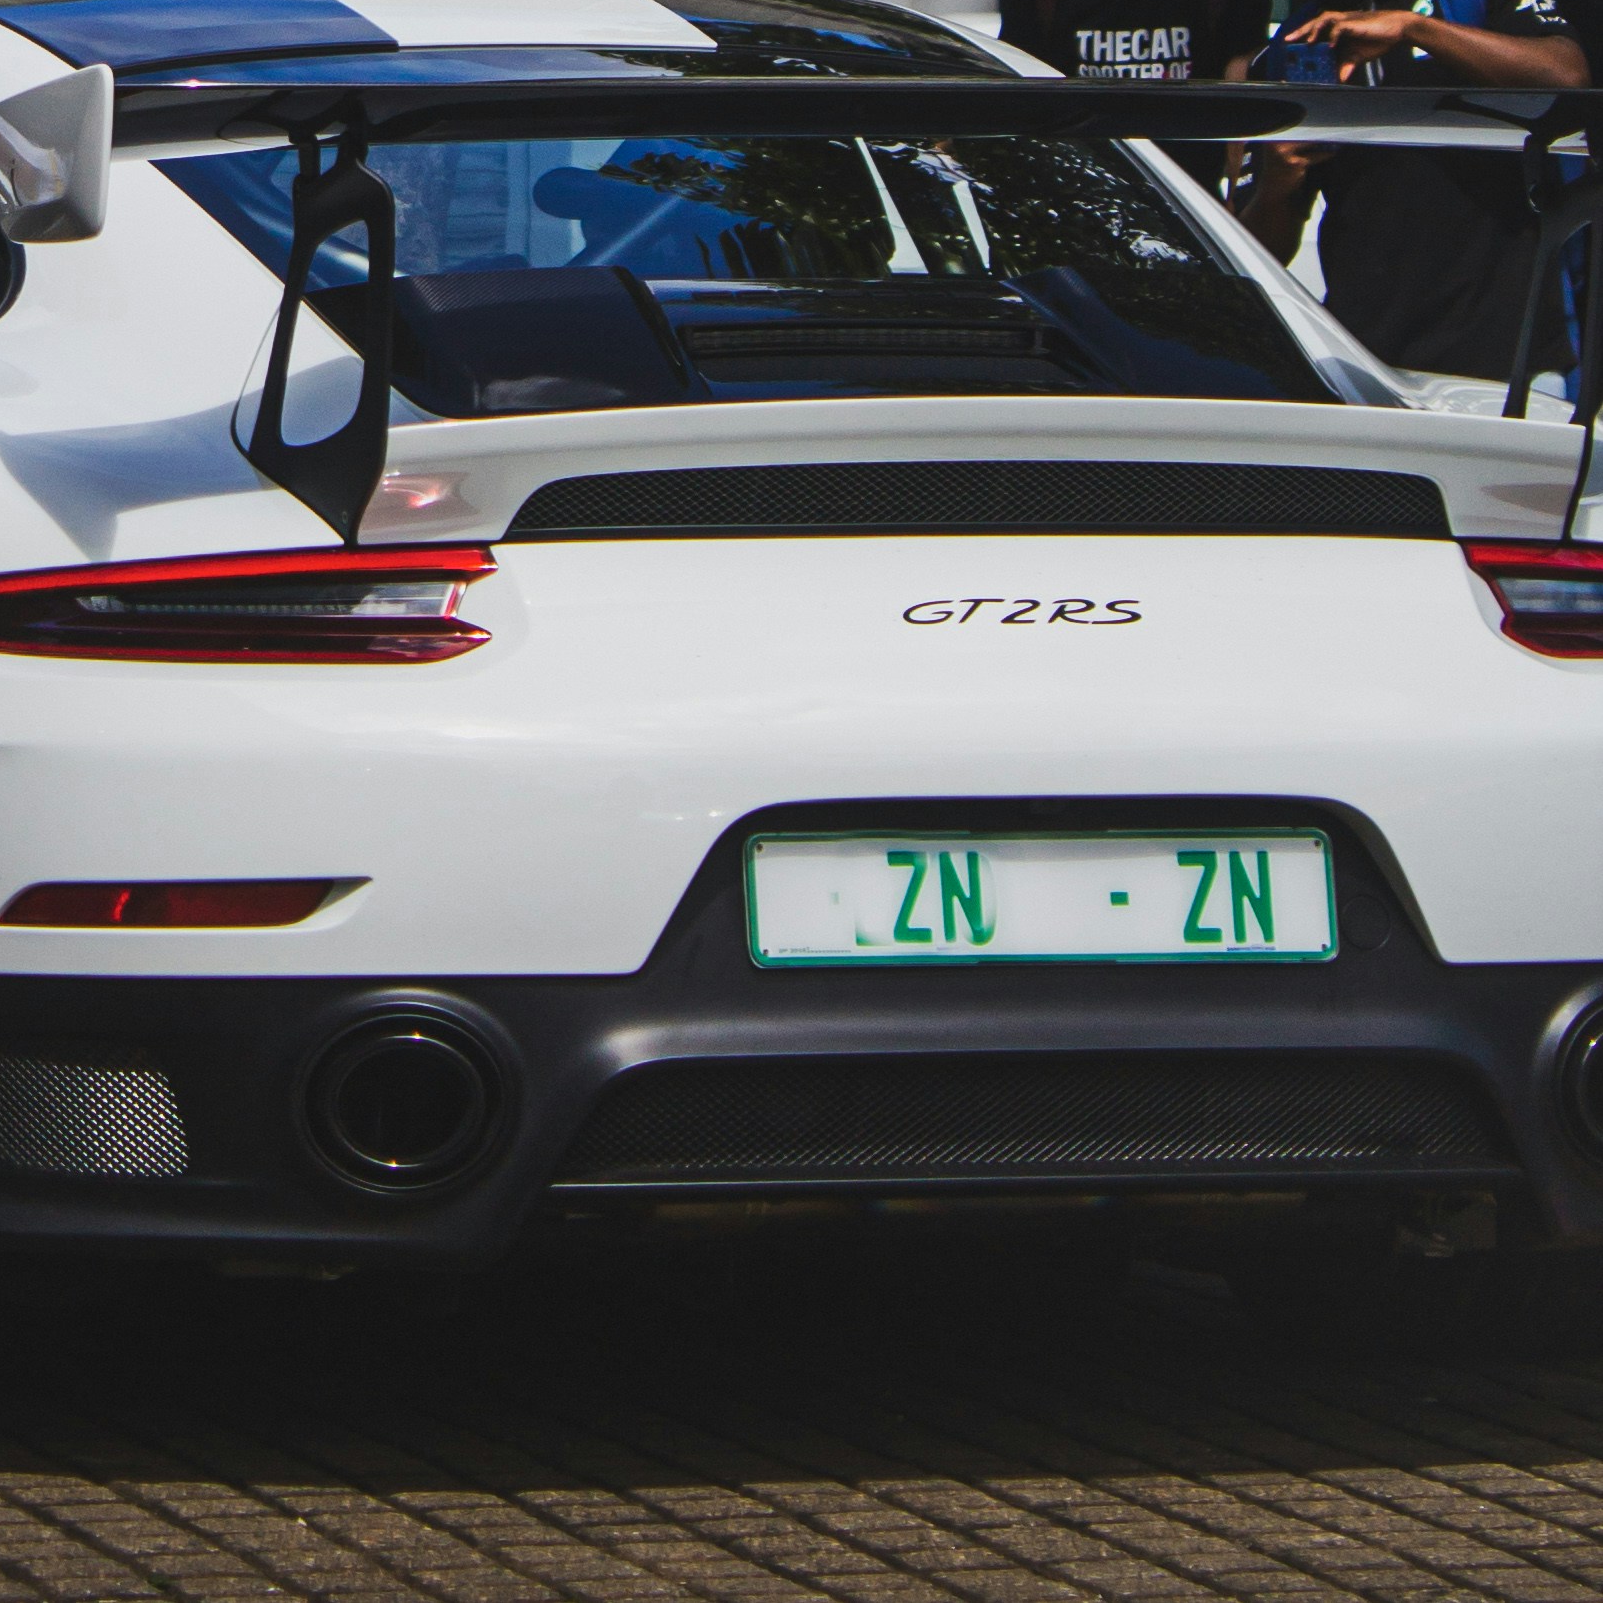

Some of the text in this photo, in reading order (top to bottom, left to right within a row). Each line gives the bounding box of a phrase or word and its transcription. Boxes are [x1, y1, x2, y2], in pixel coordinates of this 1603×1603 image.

[1076, 27, 1191, 62] THECAR
[902, 598, 1142, 625] GT2RS
[887, 851, 982, 944] ZN
[1177, 850, 1275, 944] ZN
